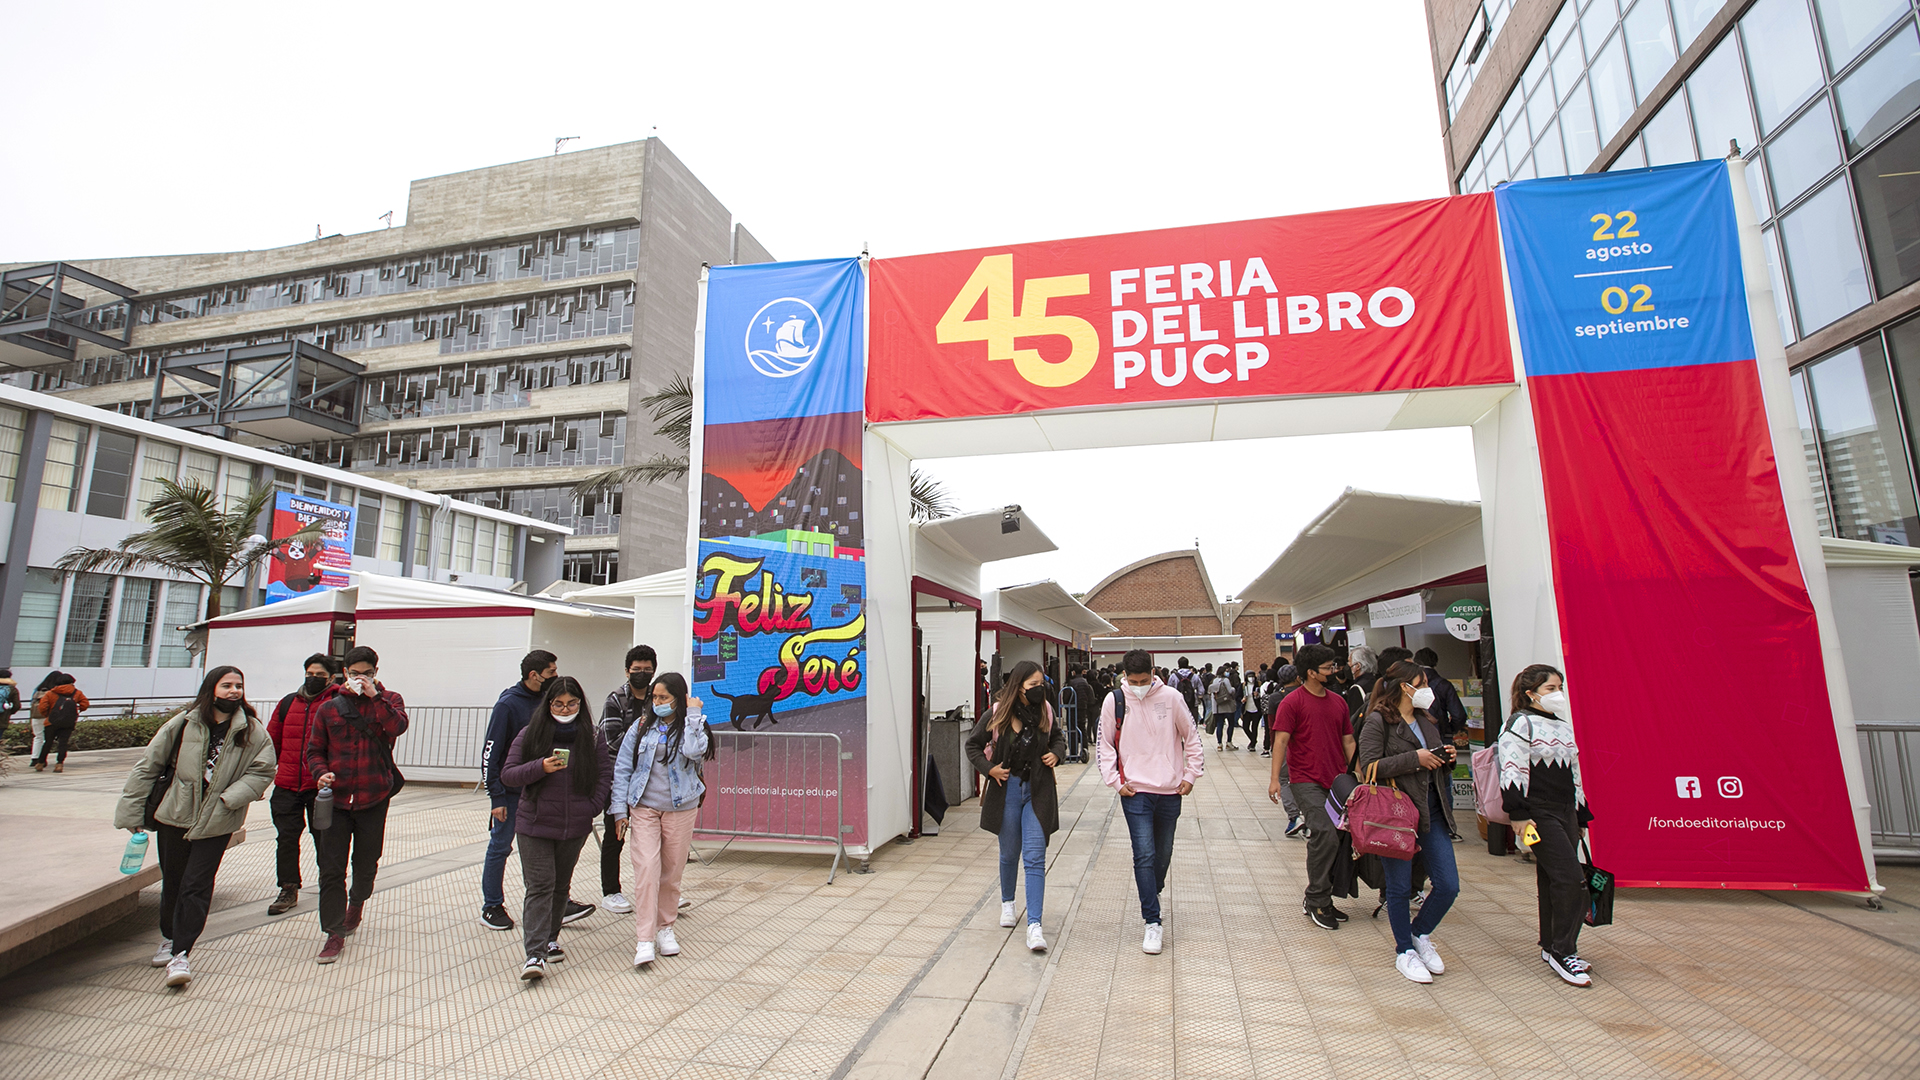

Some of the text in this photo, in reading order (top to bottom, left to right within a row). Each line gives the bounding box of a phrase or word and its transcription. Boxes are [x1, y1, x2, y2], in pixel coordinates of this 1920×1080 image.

[1590, 210, 1640, 241] 22
[1585, 241, 1653, 262] agosto
[1110, 256, 1278, 307] FERIA
[1601, 283, 1655, 315] 02
[935, 253, 1100, 388] 45
[1112, 286, 1416, 348] DEL LIBRO
[1574, 315, 1690, 339] septiembre
[1113, 341, 1271, 390] PUCP
[291, 499, 350, 520] BIENVENIDOS Y
[693, 552, 813, 641] Feliz
[1452, 605, 1483, 613] OFERTA
[1456, 623, 1468, 631] 10
[757, 614, 866, 700] Seré
[1648, 816, 1786, 832] /fondoeditorialpucp
